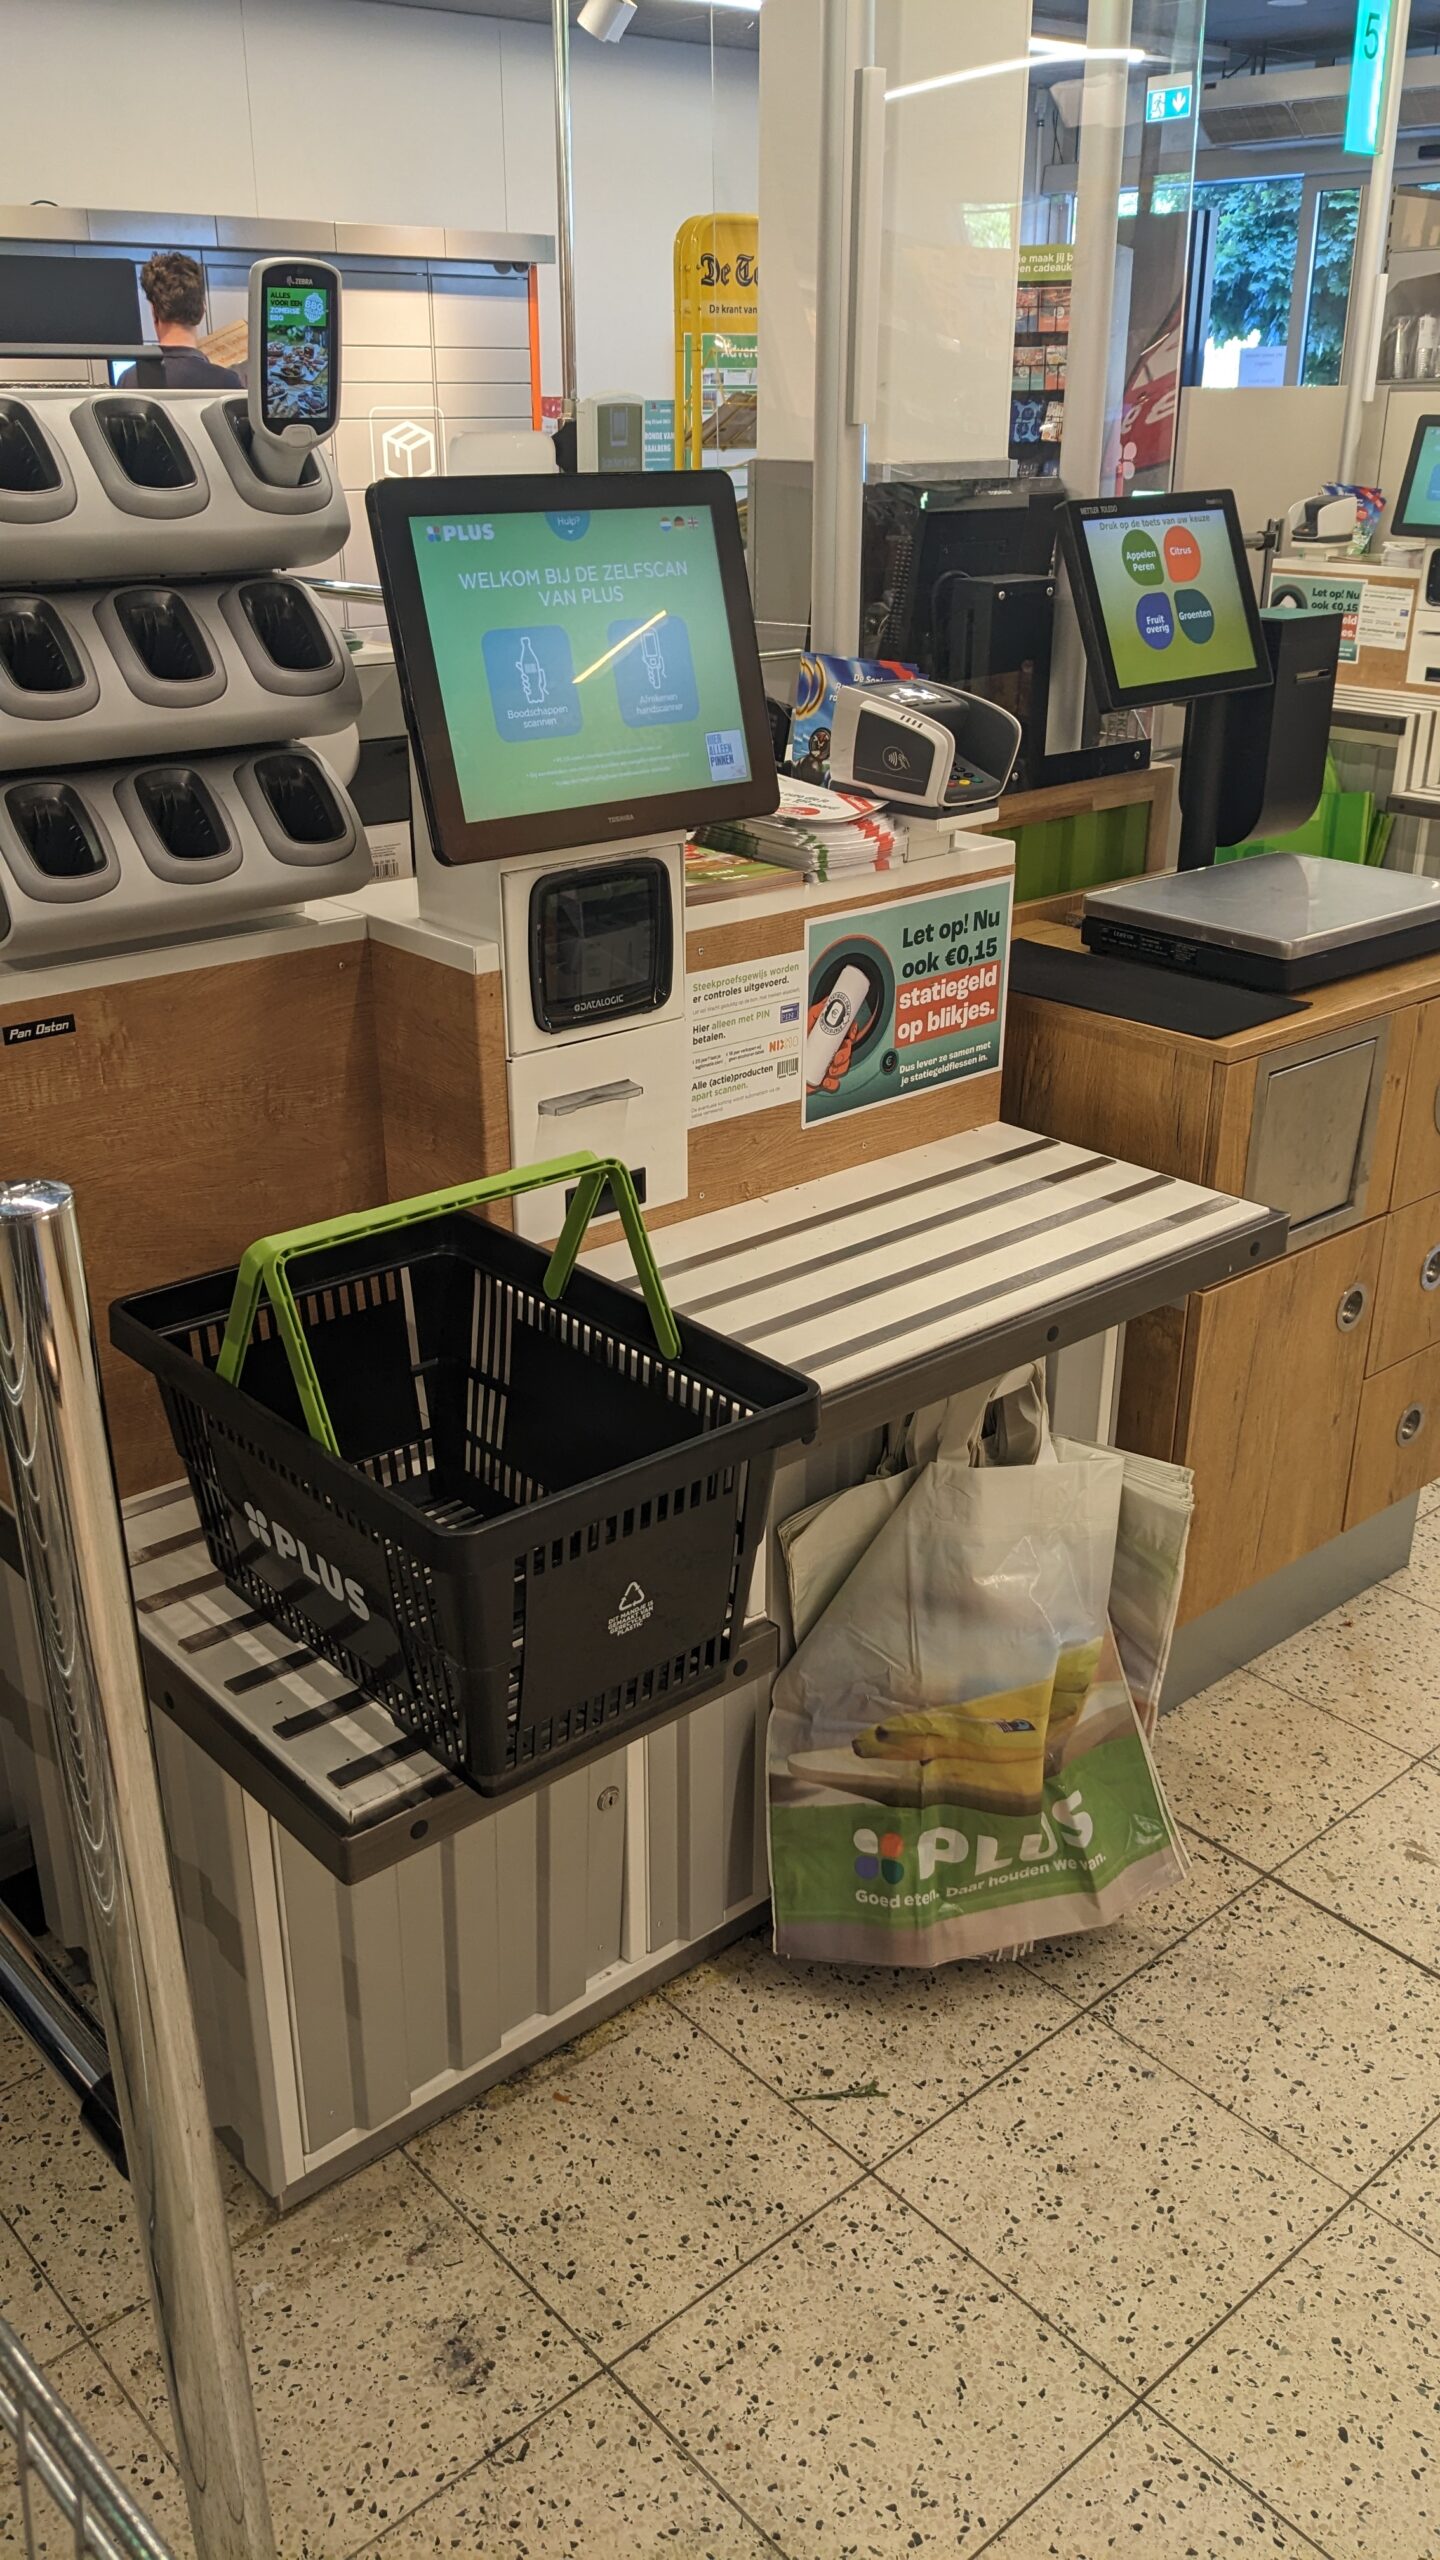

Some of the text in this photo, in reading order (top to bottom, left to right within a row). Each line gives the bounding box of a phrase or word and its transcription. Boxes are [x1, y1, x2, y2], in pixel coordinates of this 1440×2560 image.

[1364, 13, 1381, 60] 5
[1029, 253, 1055, 263] maak
[1055, 252, 1065, 264] jij
[701, 253, 731, 287] De
[270, 291, 291, 299] ALLES
[270, 299, 289, 307] VOOR
[721, 303, 743, 314] krant
[744, 306, 758, 314] van
[557, 515, 581, 527] Hulp?
[1099, 514, 1211, 531] Druk op de toets van uw keuze
[443, 523, 495, 542] PLUS
[1126, 549, 1157, 562] Appelen
[1169, 546, 1193, 556] Citrus
[458, 560, 688, 590] WELKOM BIJ DE ZELFSCAN
[1132, 562, 1155, 572] Peren
[538, 586, 624, 607] VAN PLUS
[1312, 587, 1329, 597] Let
[1329, 589, 1345, 600] op!
[1346, 590, 1360, 600] Nu
[1311, 601, 1328, 610] ook
[1146, 614, 1165, 625] Fruit
[1178, 609, 1212, 621] Groenten
[1146, 623, 1170, 636] overig
[507, 705, 569, 719] Boodschappen
[523, 718, 558, 729] scannen
[708, 743, 733, 755] ALLEEN
[710, 752, 735, 766] PINNEN
[902, 909, 1000, 949] Let op! Nu
[902, 936, 998, 978] ook €0,15
[693, 963, 800, 992] Steekproefsgewijs worden
[692, 995, 702, 1004] er
[703, 985, 742, 1002] controles
[744, 976, 790, 993] uitgevoerd.
[899, 964, 998, 1010] statiegeld
[580, 993, 624, 1012] DATALOGIC
[692, 1009, 771, 1035] Hier alleen met PIN
[897, 1000, 995, 1042] op blikjes.
[9, 1028, 32, 1041] Pan
[692, 1032, 726, 1046] betalen.
[899, 1041, 991, 1074] Dus lever ze samen met
[691, 1064, 774, 1091] Alle (actie)producten
[900, 1053, 989, 1088] je statiegeldflessen in.
[691, 1090, 715, 1103] apart
[714, 1082, 749, 1096] scannen.
[272, 1520, 371, 1622] PLUS
[917, 1789, 1094, 1880] PLUS
[855, 1889, 901, 1909] Goed
[904, 1889, 940, 1908] eten.
[945, 1879, 986, 1898] Daar
[988, 1863, 1051, 1888] houden
[1080, 1852, 1107, 1872] van.
